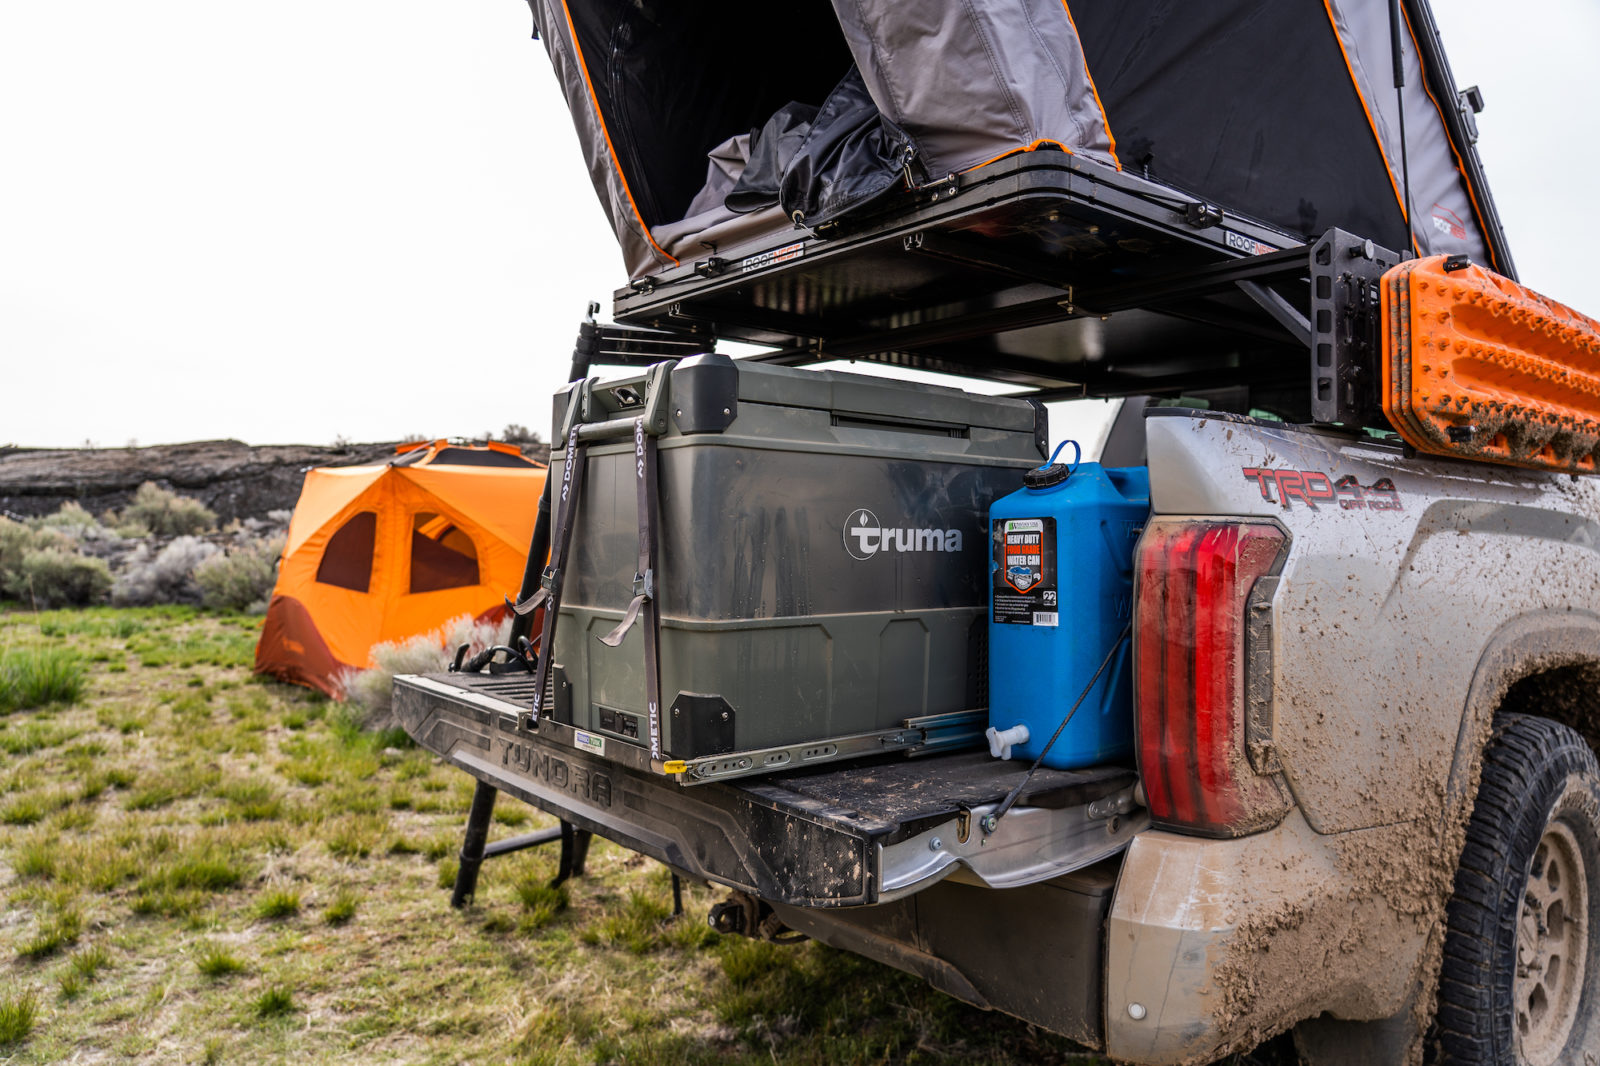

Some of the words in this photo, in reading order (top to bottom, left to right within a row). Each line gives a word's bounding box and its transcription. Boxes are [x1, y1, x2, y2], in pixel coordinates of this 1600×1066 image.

[1242, 467, 1338, 512] TRD
[1339, 499, 1366, 510] OFF
[1368, 500, 1403, 512] ROAD
[849, 522, 963, 555] truma
[1007, 535, 1024, 545] HEAVY
[1025, 534, 1040, 544] DUTY
[1007, 545, 1021, 554] FOOD
[1022, 545, 1040, 554] GRADE
[1007, 555, 1027, 566] WATER
[1028, 555, 1040, 566] CAN
[1044, 592, 1056, 601] 22
[498, 737, 612, 807] TUNDRA
